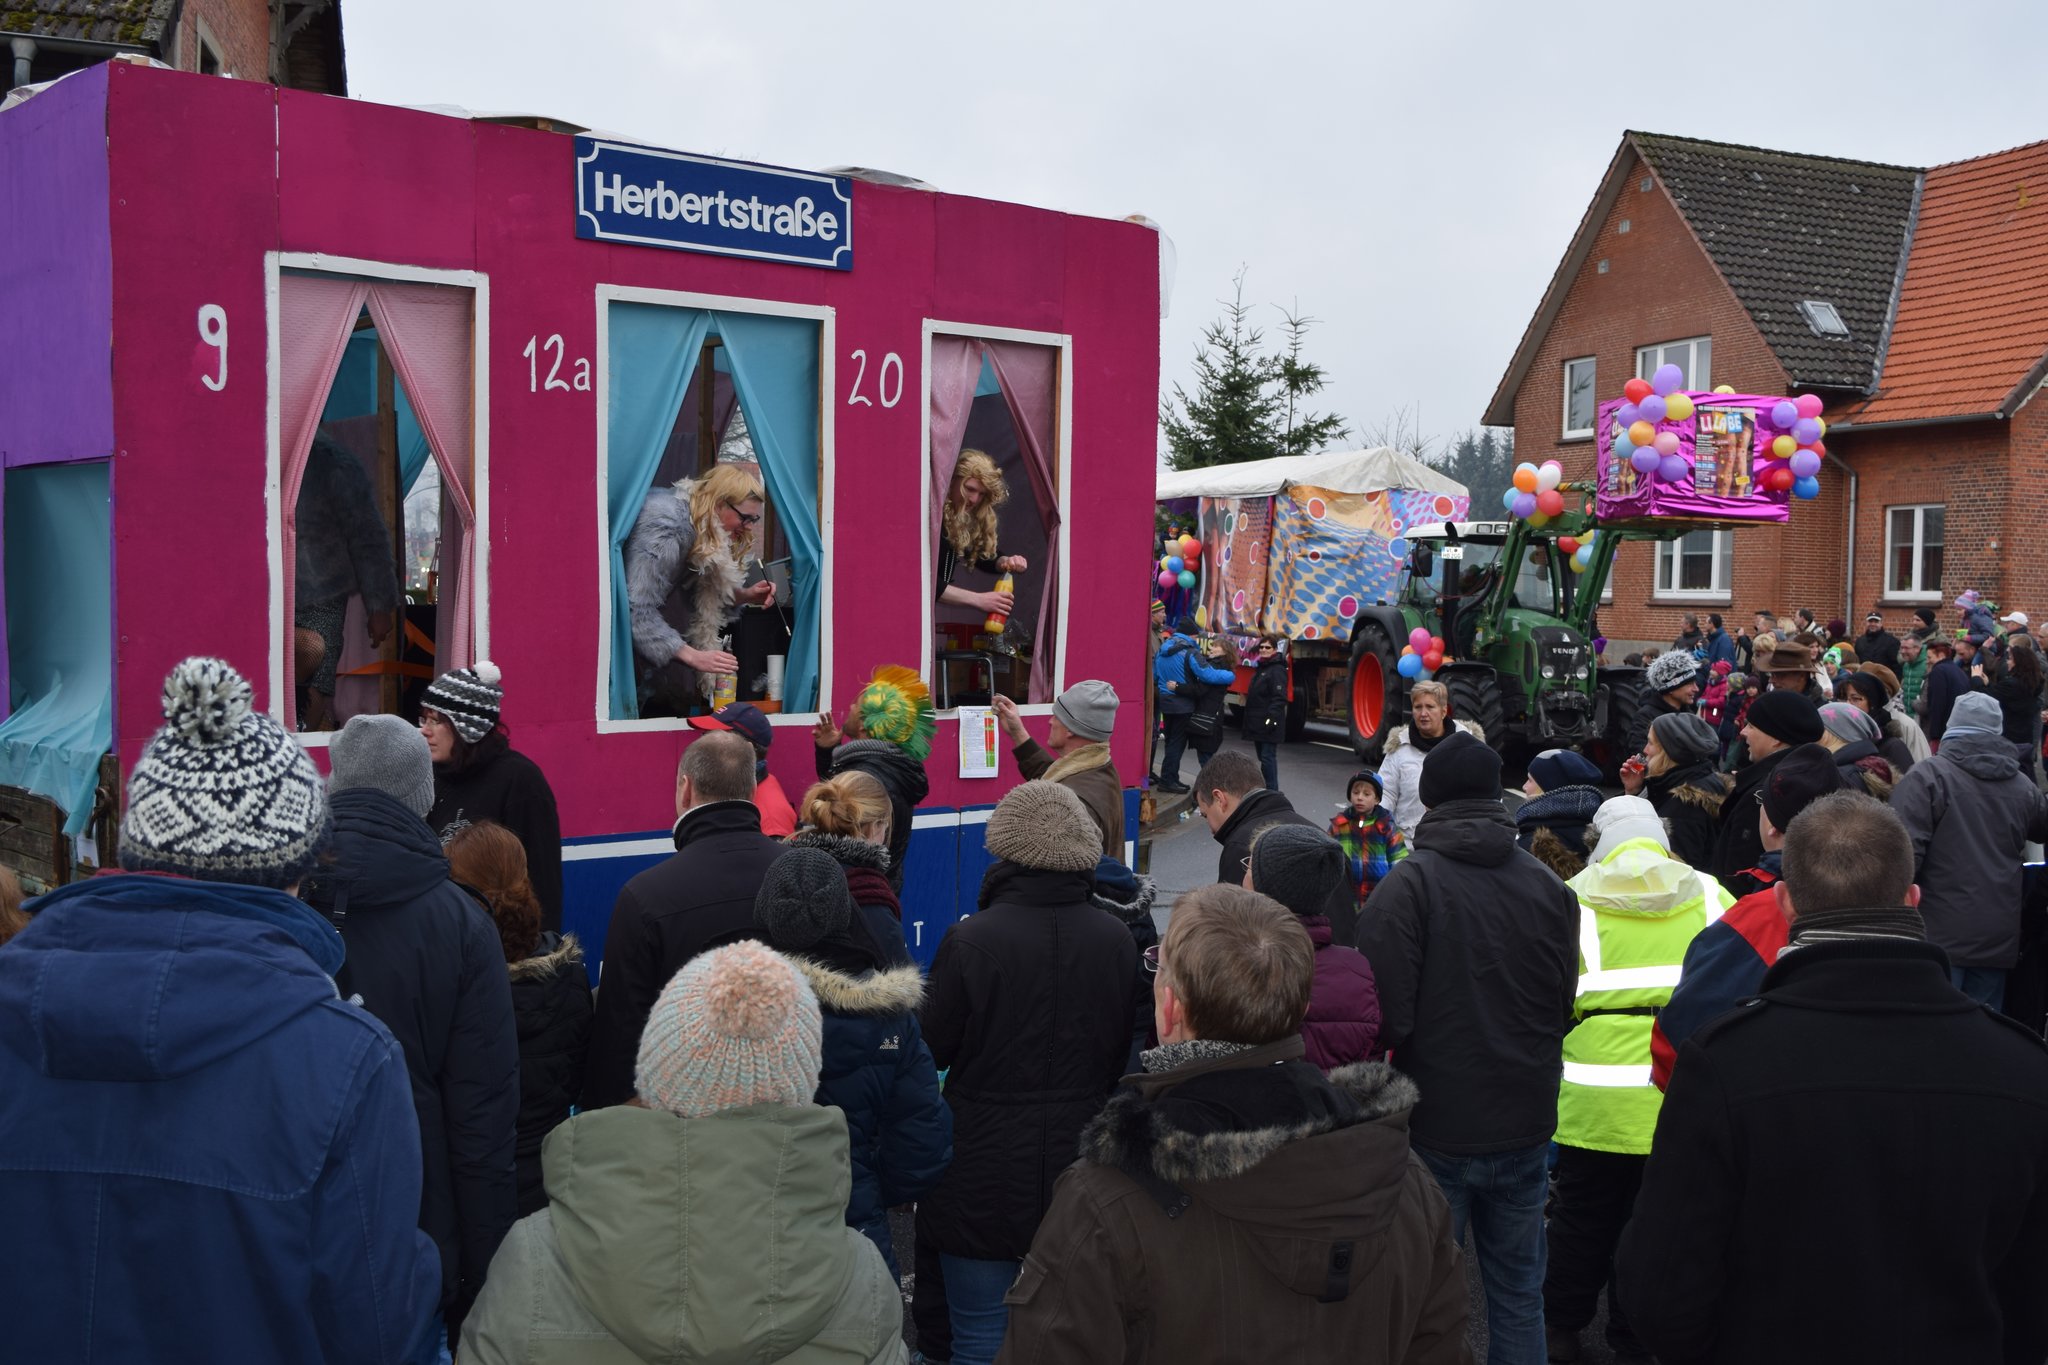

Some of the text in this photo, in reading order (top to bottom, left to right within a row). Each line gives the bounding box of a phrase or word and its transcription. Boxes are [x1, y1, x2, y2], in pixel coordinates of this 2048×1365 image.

[595, 172, 838, 241] Herbertstraße
[198, 303, 228, 391] 9
[523, 334, 591, 392] 12a
[848, 349, 903, 408] 20
